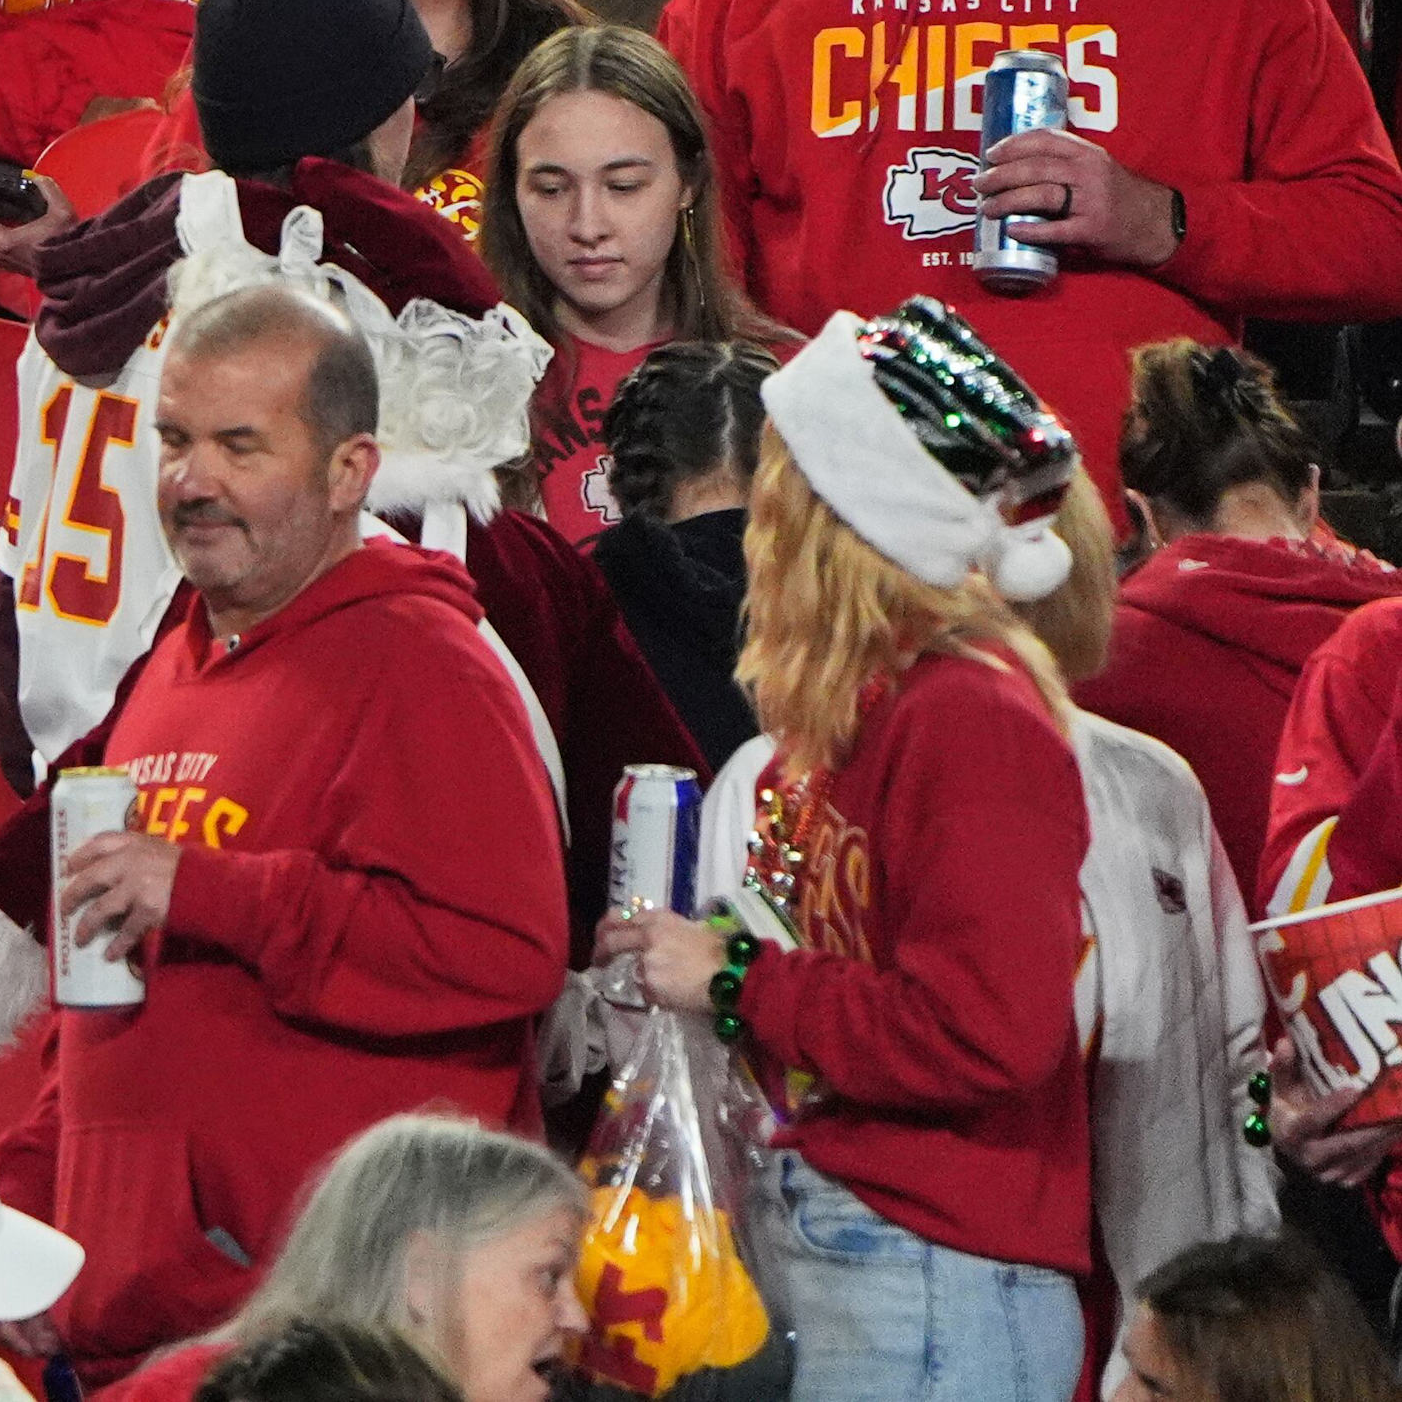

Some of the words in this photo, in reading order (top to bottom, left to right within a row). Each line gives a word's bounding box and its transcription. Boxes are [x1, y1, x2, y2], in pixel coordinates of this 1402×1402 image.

[809, 22, 1120, 139] CHIES
[922, 252, 953, 267] EST.
[18, 384, 141, 629] 15
[128, 751, 174, 785] NSAS
[175, 752, 220, 783] CITY
